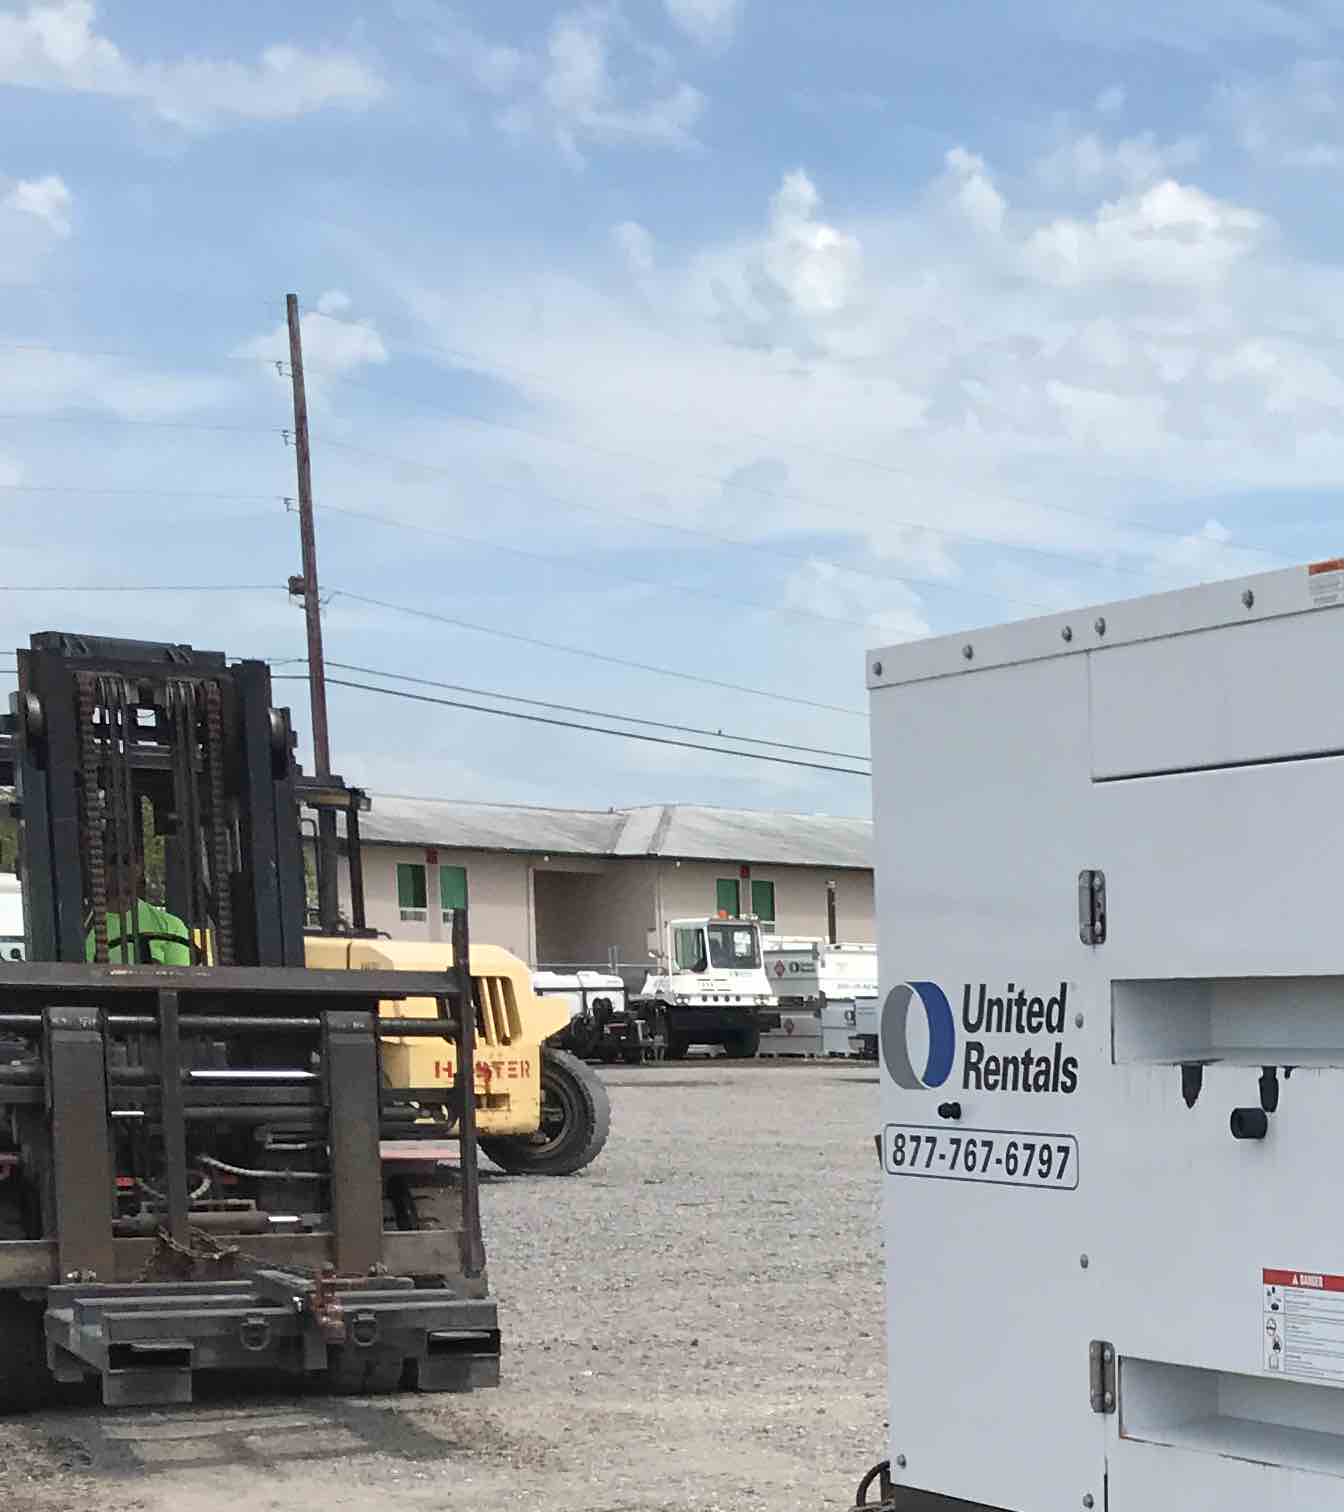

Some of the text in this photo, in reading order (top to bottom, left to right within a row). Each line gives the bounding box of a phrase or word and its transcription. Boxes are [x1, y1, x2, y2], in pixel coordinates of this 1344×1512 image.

[962, 982, 1068, 1034] United
[435, 1061, 530, 1079] HSTER
[962, 1041, 1079, 1094] Rentals
[892, 1133, 1071, 1180] 877-767-6797
